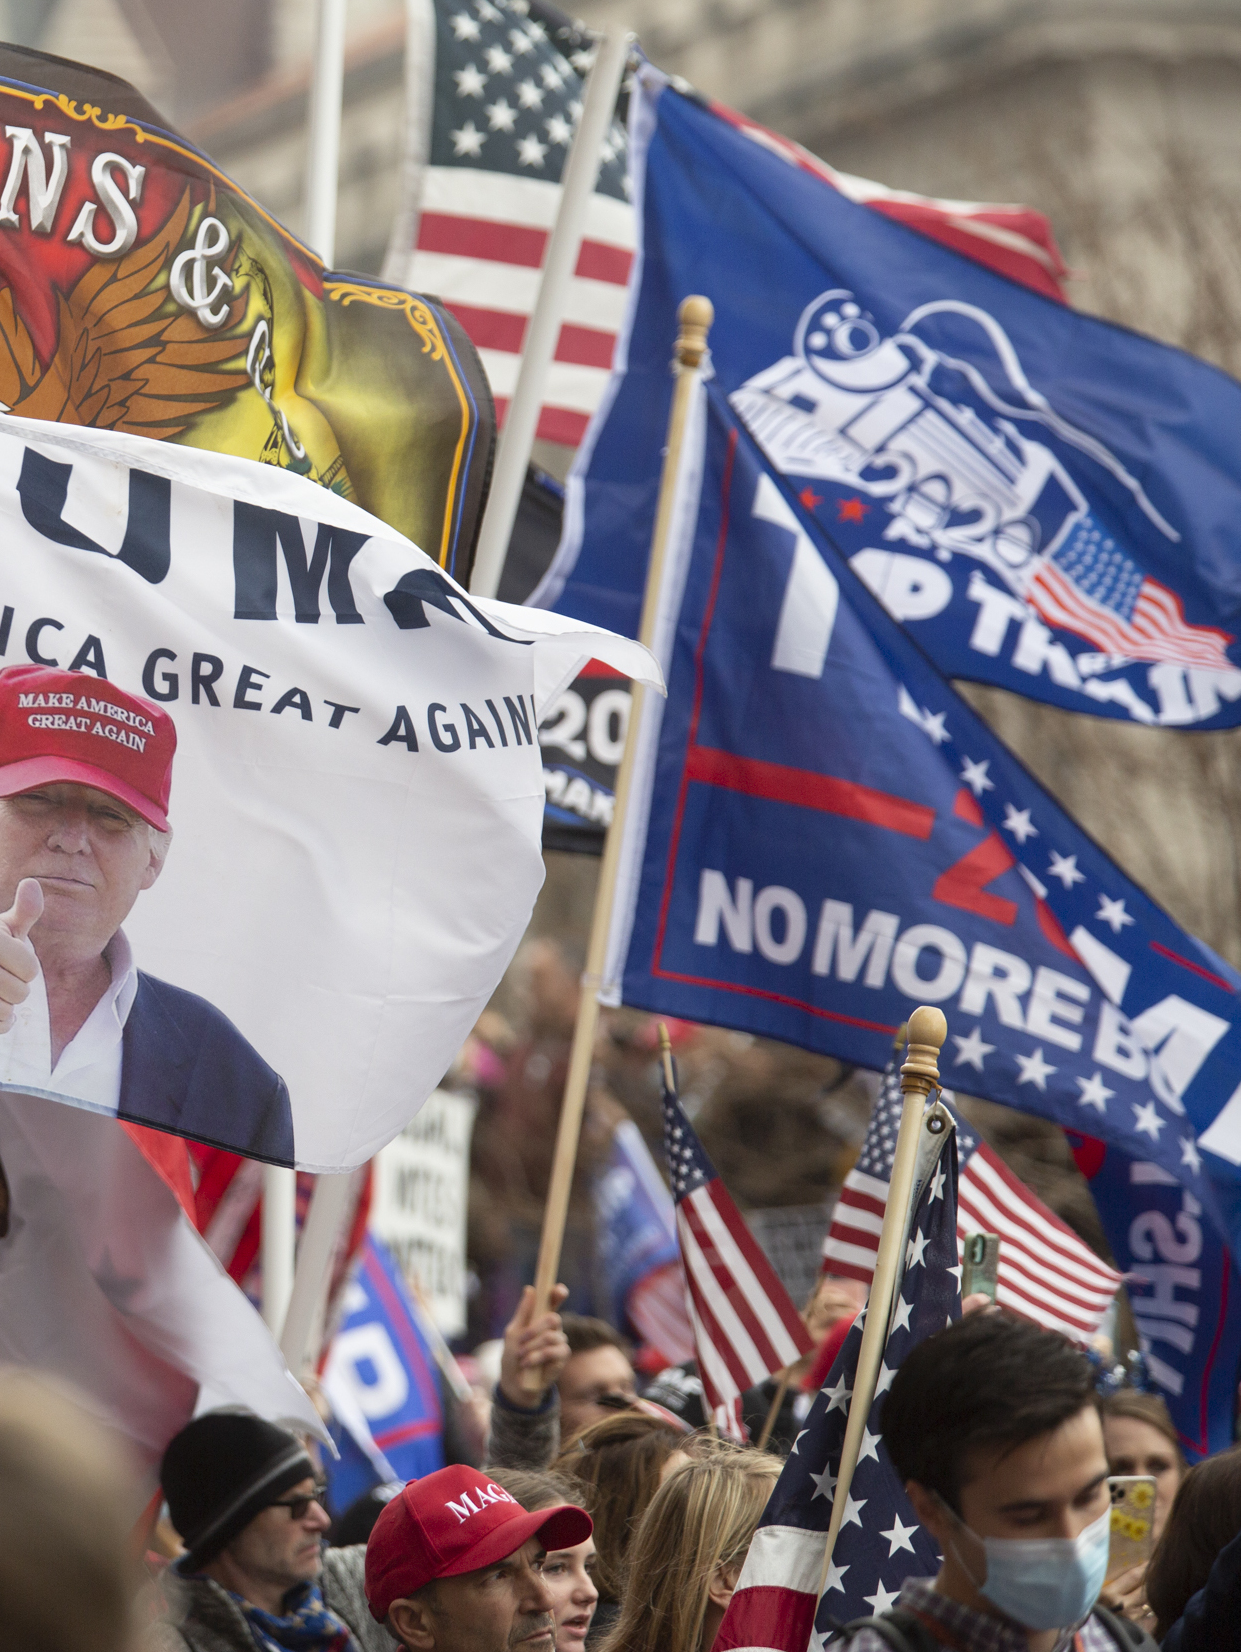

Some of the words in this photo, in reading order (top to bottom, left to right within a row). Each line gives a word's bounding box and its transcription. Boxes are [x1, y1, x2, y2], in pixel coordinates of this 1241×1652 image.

[170, 217, 230, 329] &
[18, 693, 74, 709] MAKE
[76, 696, 156, 736] AMERICA
[28, 714, 91, 732] GREAT
[92, 722, 147, 753] AGAIN
[141, 647, 361, 730] GREAT
[376, 693, 538, 753] AGAIN
[693, 868, 808, 966] NO
[811, 898, 1091, 1053] MORE
